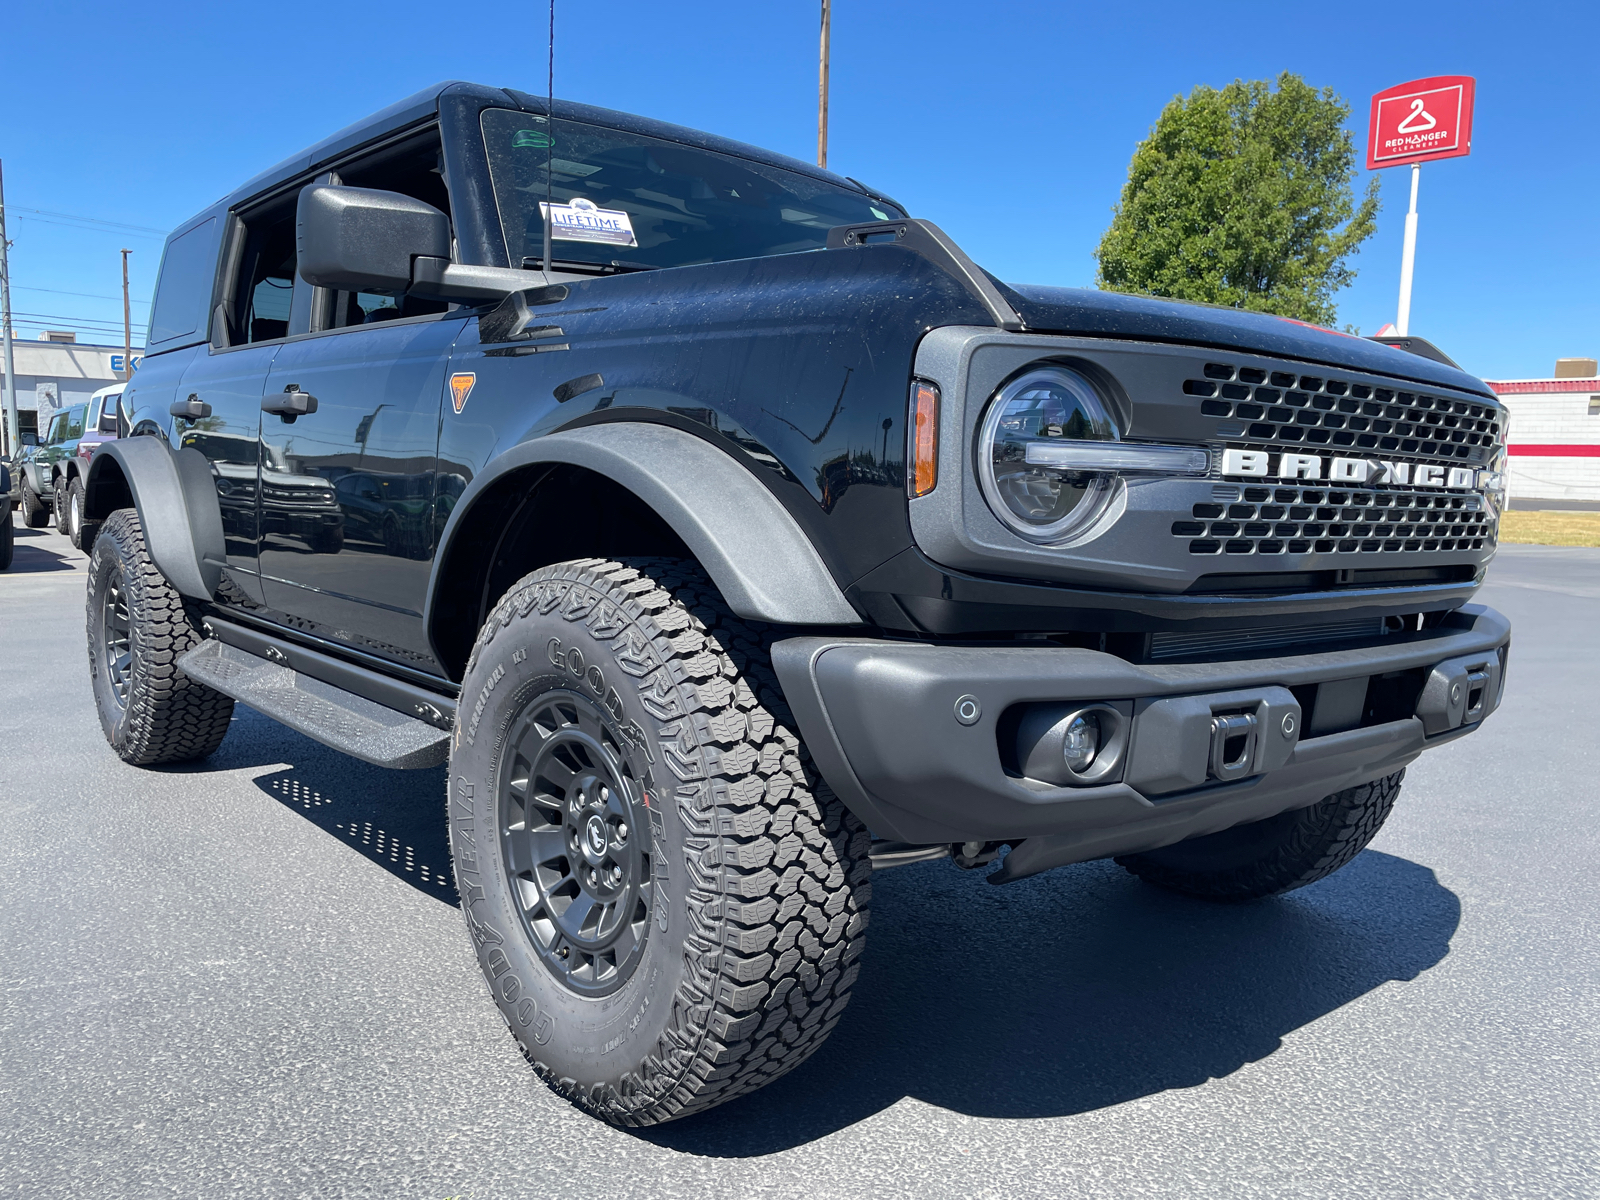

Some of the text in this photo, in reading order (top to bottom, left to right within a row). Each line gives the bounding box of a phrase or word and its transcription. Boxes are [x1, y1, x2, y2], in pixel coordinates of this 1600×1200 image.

[1385, 130, 1448, 148] RED HANGER
[1392, 140, 1439, 152] CLEANERS
[553, 213, 622, 230] LIFETIME
[110, 355, 145, 371] EK
[1221, 448, 1474, 489] BRONCO
[466, 663, 506, 746] TERRITORY
